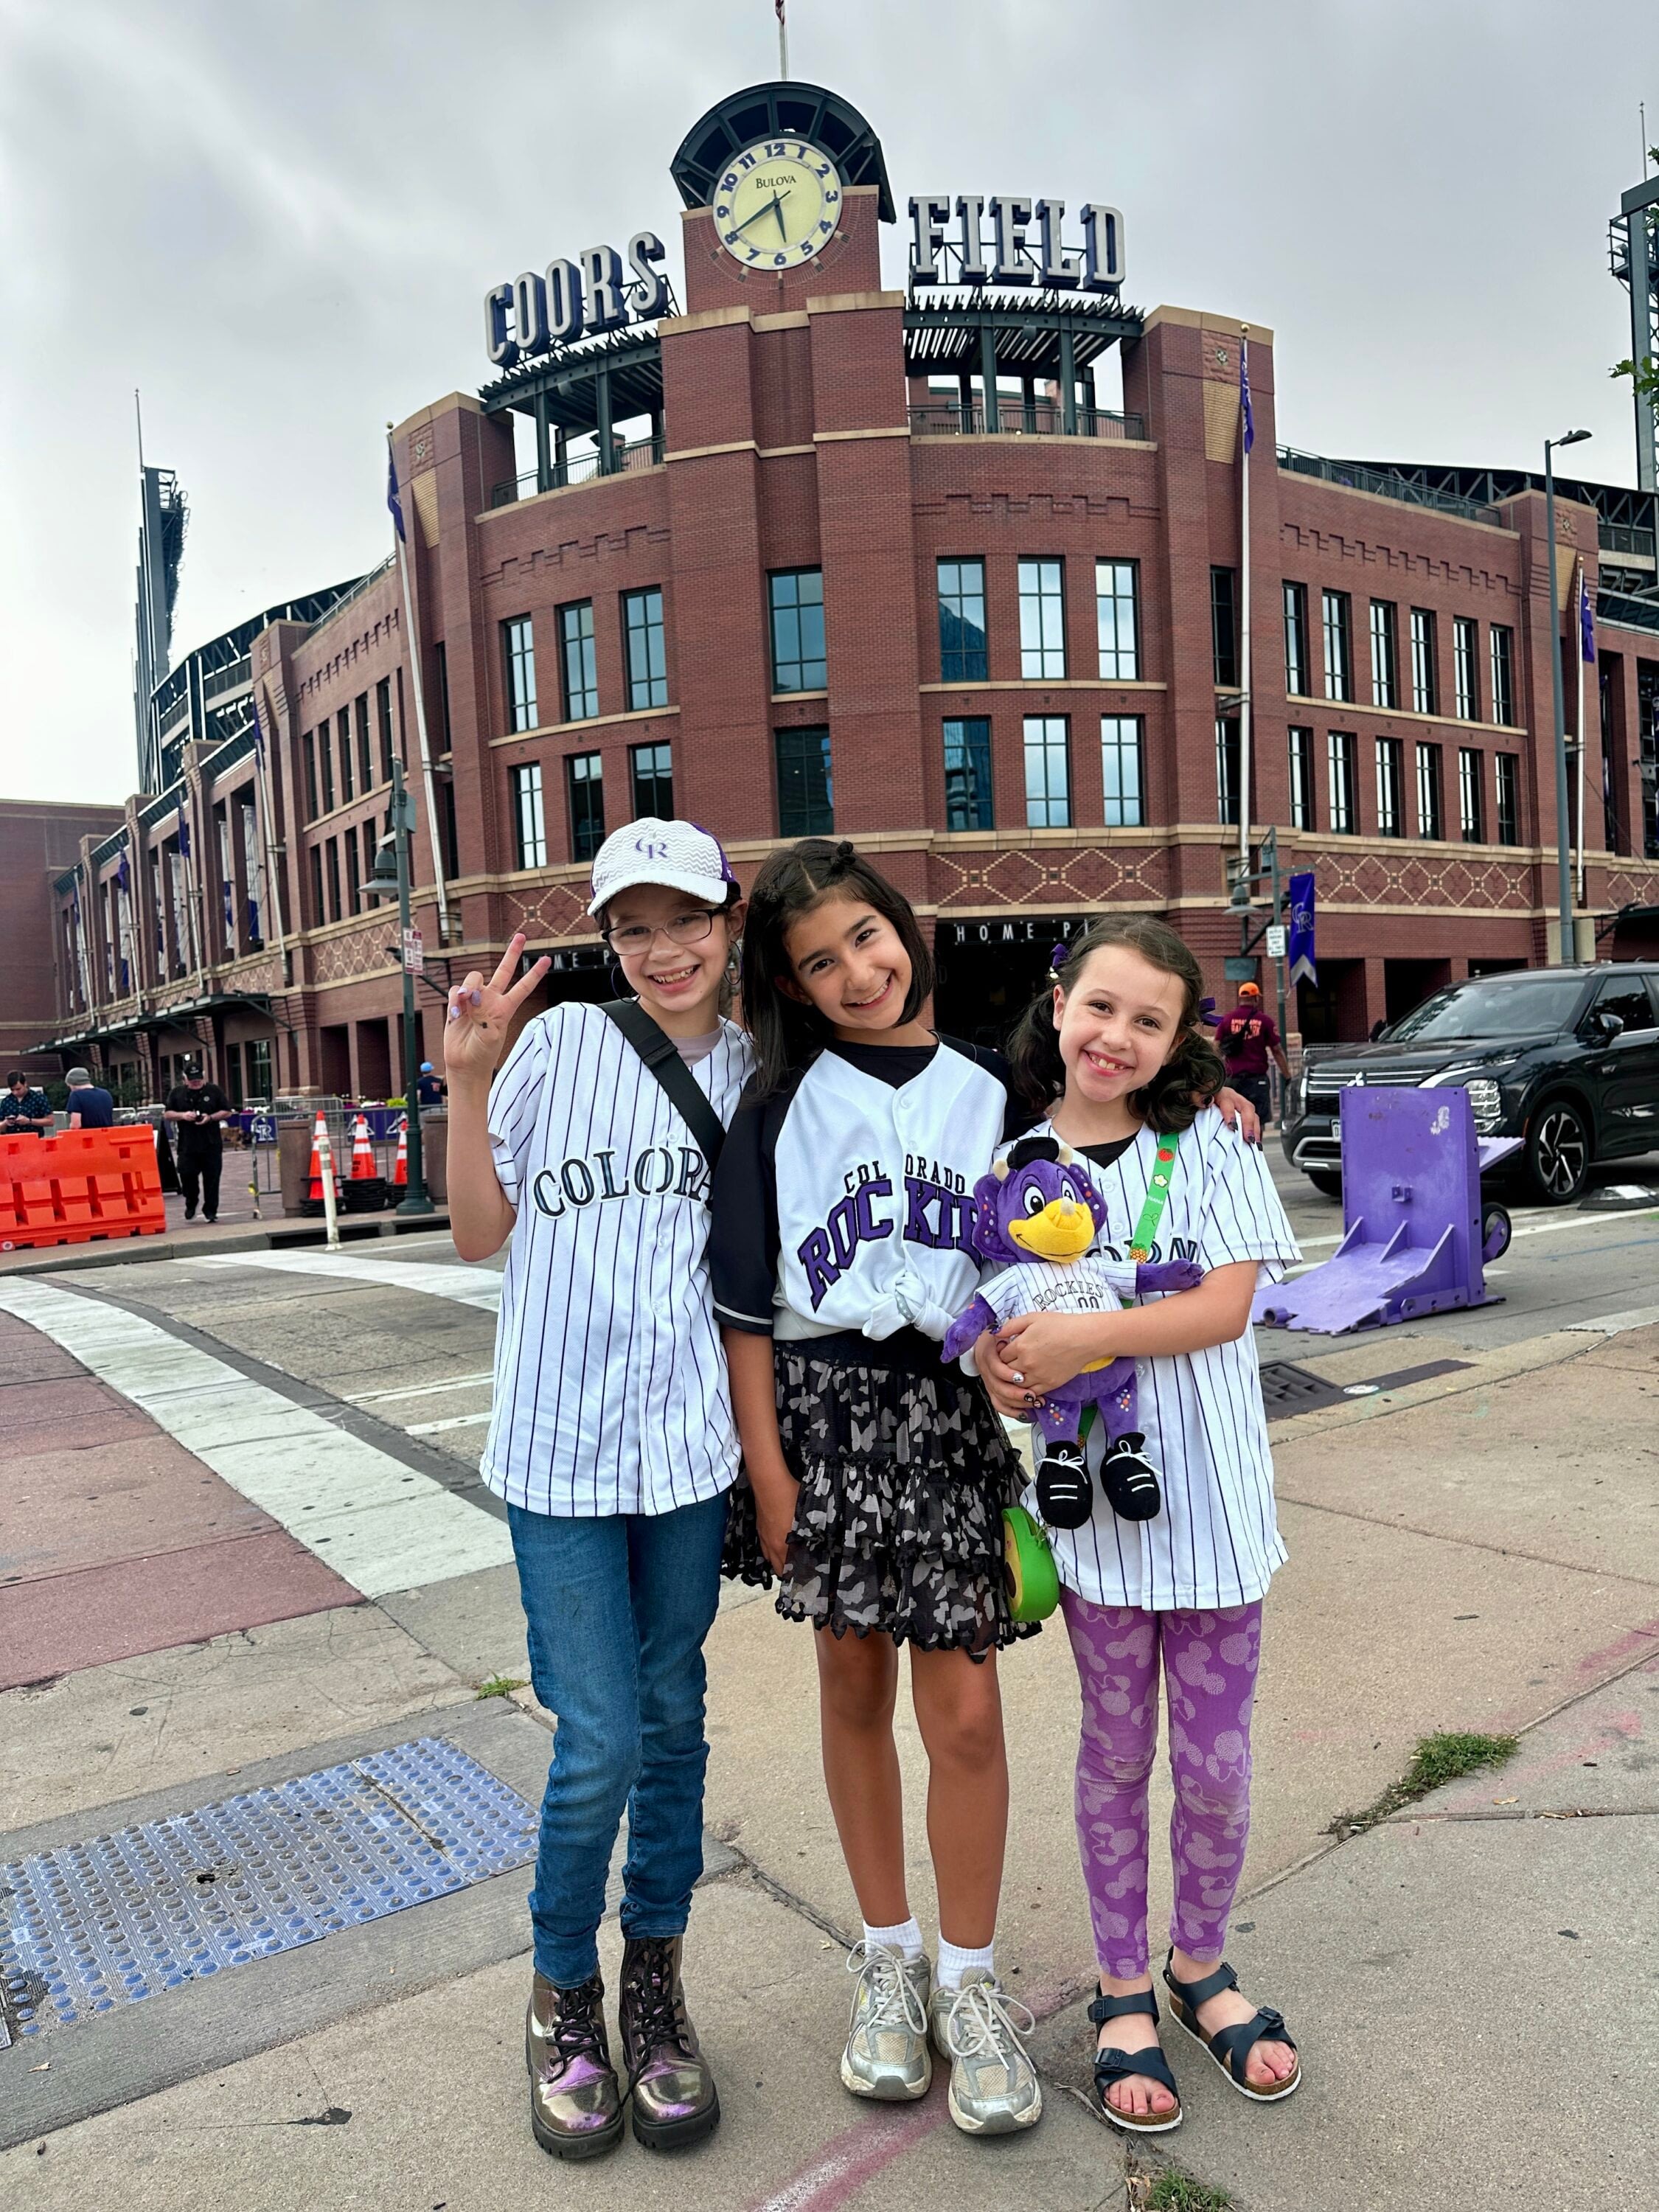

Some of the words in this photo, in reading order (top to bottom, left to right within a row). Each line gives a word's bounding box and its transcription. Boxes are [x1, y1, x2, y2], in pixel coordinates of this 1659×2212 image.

[765, 143, 785, 157] 12
[797, 146, 807, 159] 1
[738, 153, 757, 170] 11
[815, 164, 830, 178] 2
[720, 173, 738, 192] 10
[826, 190, 838, 203] 3
[717, 205, 730, 218] 9
[819, 220, 832, 234] 4
[724, 231, 739, 245] 8
[745, 248, 761, 261] 7
[800, 240, 813, 256] 5
[774, 253, 787, 265] 6
[484, 231, 667, 368] COORS
[908, 195, 1126, 289] FIELD
[957, 922, 1034, 942] HOME
[523, 951, 578, 975] HME
[1032, 1281, 1104, 1312] ROCKIES
